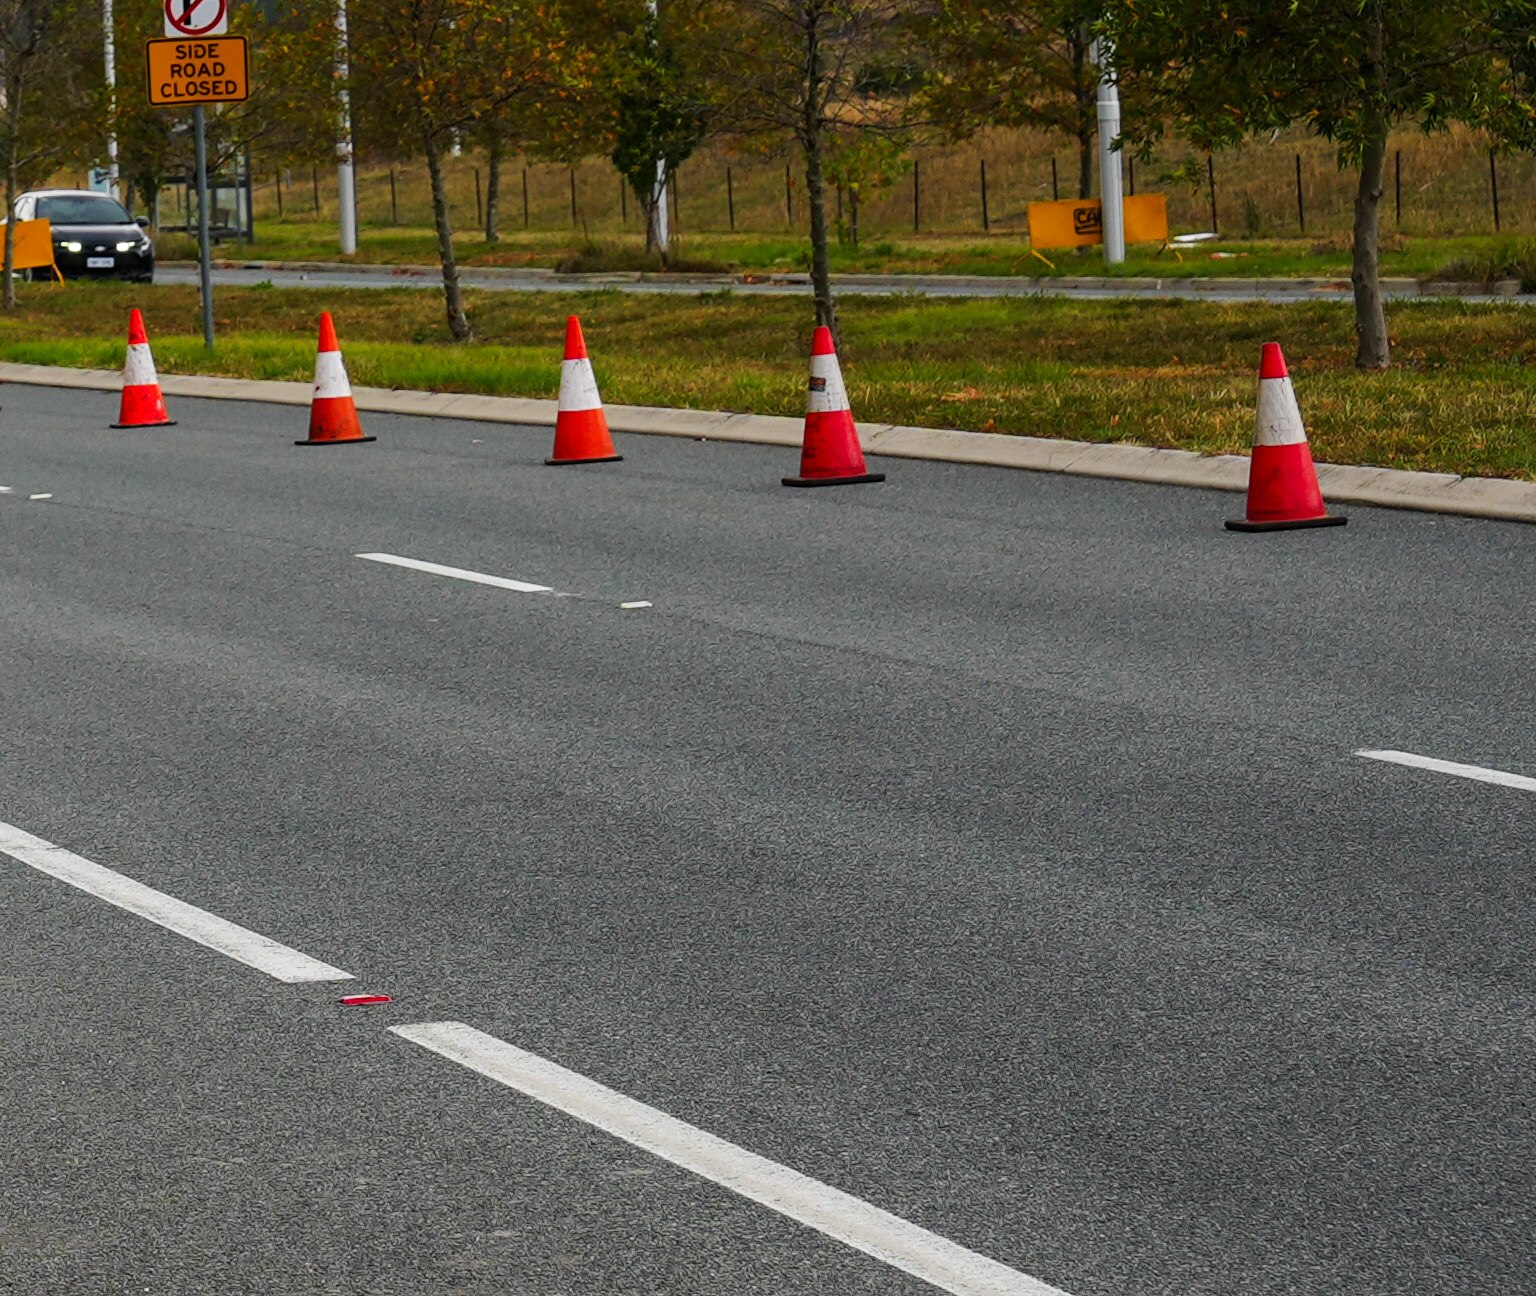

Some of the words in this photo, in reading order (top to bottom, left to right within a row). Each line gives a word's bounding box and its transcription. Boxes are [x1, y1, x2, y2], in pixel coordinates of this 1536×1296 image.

[175, 43, 220, 60] SIDE
[170, 62, 225, 79] ROAD
[160, 80, 238, 98] CLOSED
